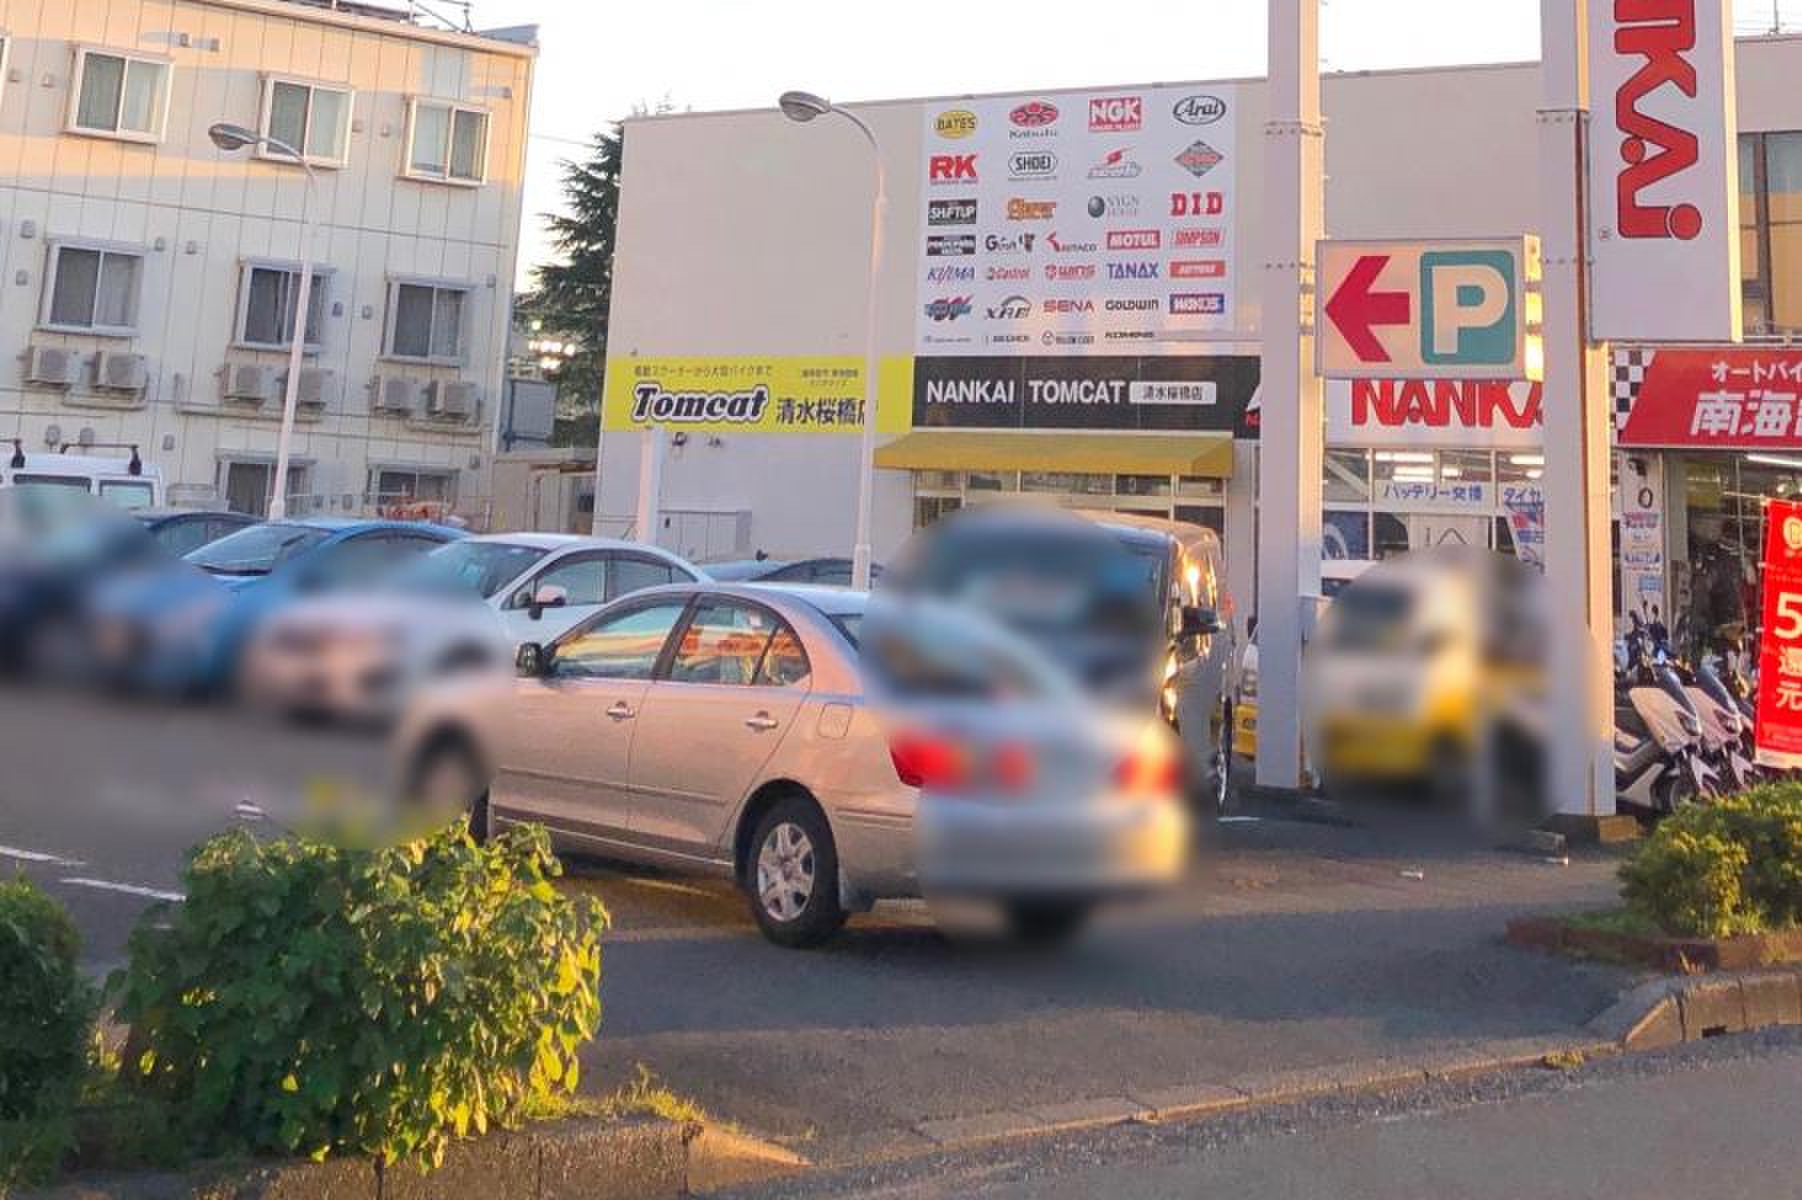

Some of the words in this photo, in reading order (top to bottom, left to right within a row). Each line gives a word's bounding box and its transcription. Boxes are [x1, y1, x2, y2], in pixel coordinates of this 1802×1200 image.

[1089, 97, 1140, 122] NGK
[929, 154, 977, 178] RK
[1015, 156, 1051, 171] SHOEI
[1110, 234, 1157, 247] MOTUL
[1107, 262, 1159, 279] TANAX
[1043, 299, 1095, 312] SENA
[1105, 299, 1159, 311] GOLDWIN
[1432, 264, 1508, 354] P
[632, 382, 769, 424] Tomcat
[927, 380, 1015, 403] NANKAI
[1028, 380, 1126, 404] TOMCAT
[1690, 389, 1802, 436] 南海
[1774, 591, 1802, 639] 5
